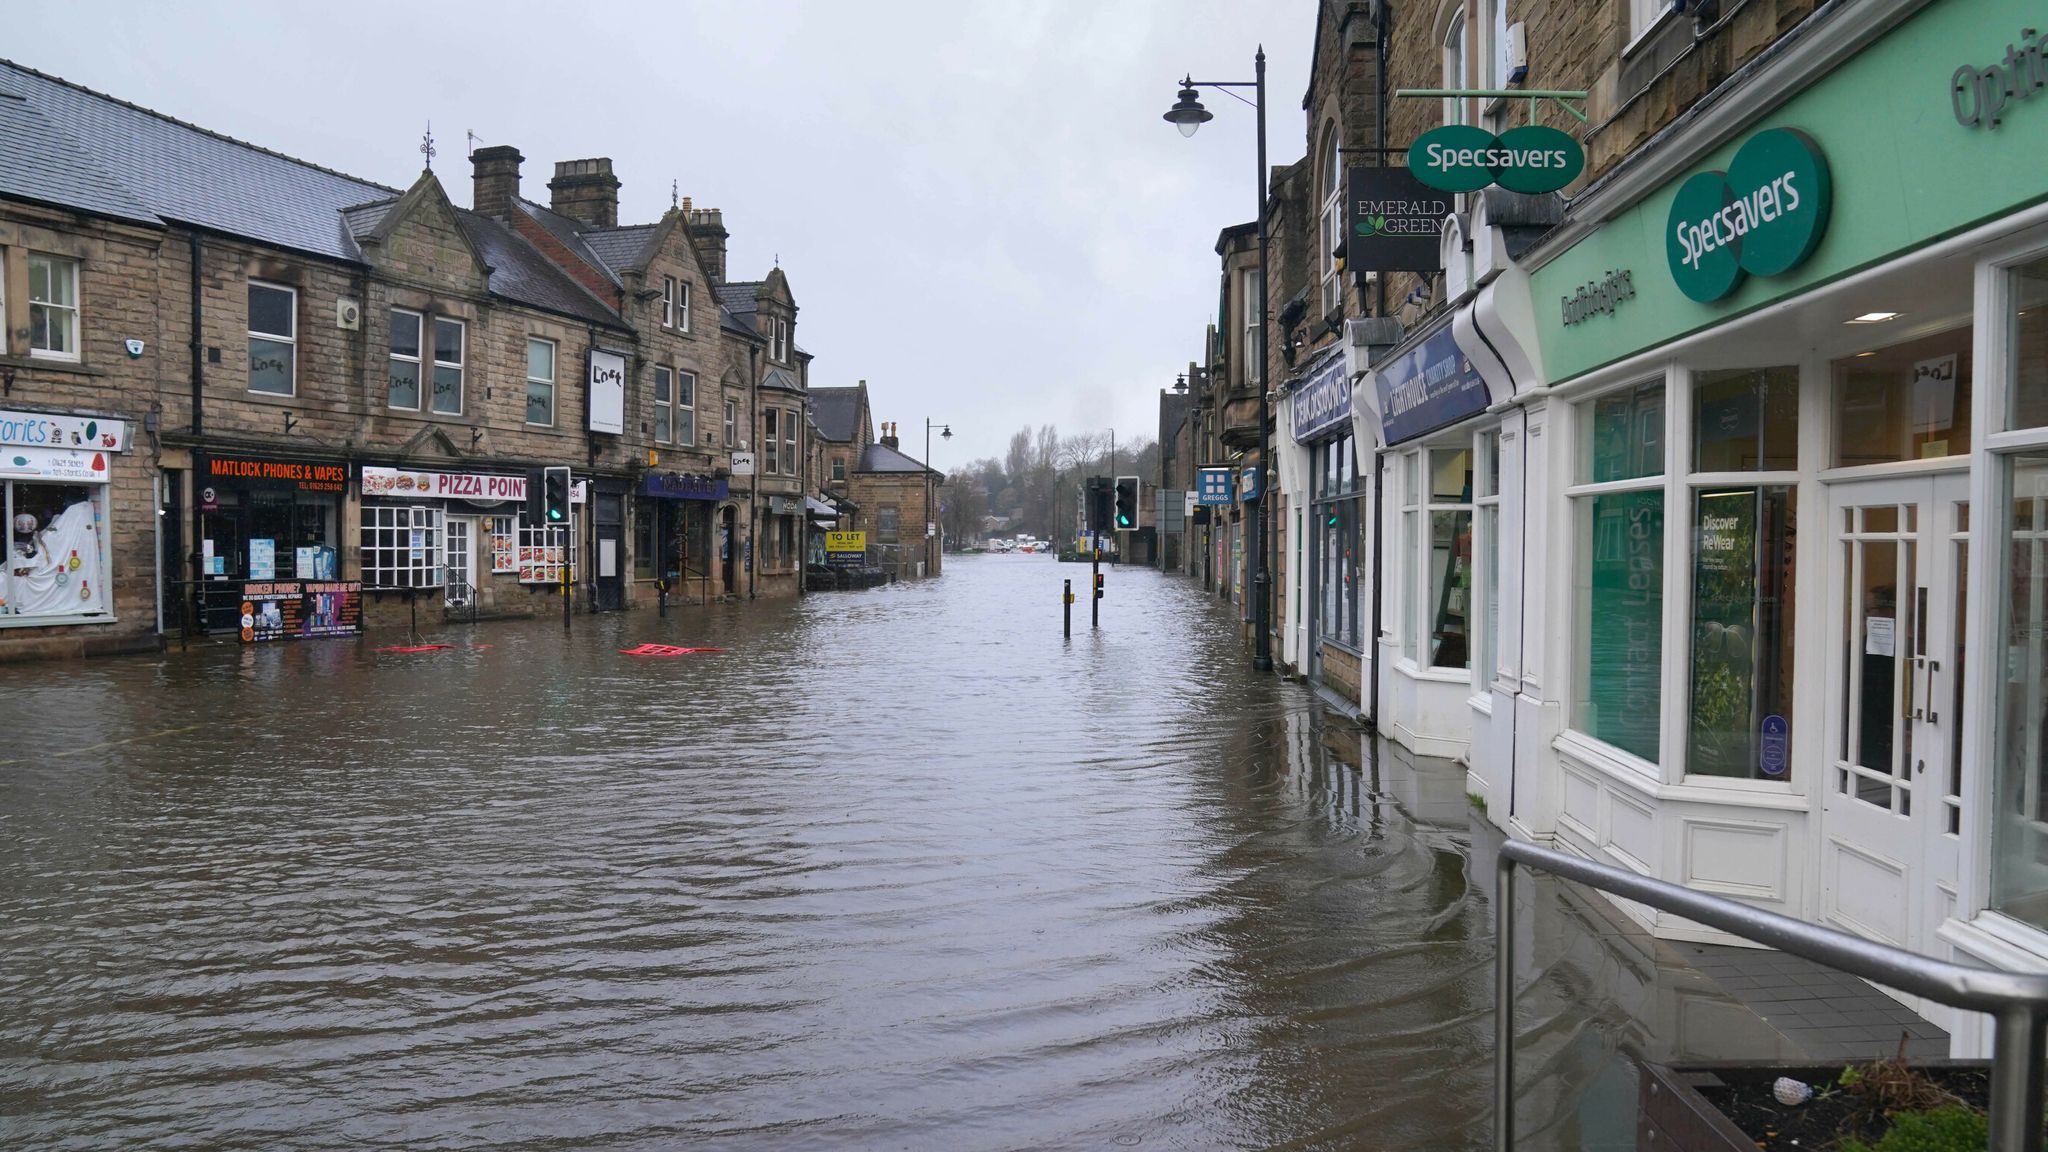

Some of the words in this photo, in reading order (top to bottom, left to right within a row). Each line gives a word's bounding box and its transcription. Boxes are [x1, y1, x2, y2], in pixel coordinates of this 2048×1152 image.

[1426, 143, 1567, 172] Specsavers
[1358, 200, 1446, 215] EMERALD
[1384, 218, 1444, 233] GREEN
[1677, 170, 1800, 271] Specsavers
[0, 418, 47, 443] ories
[211, 459, 261, 477] MATLOCK
[263, 462, 302, 479] PHONES
[304, 465, 312, 480] &
[314, 466, 344, 481] VAPES
[438, 474, 483, 496] PIZZA
[1703, 514, 1739, 531] Discover
[832, 533, 843, 541] TO
[846, 533, 860, 541] LET
[1703, 535, 1735, 551] ReWear
